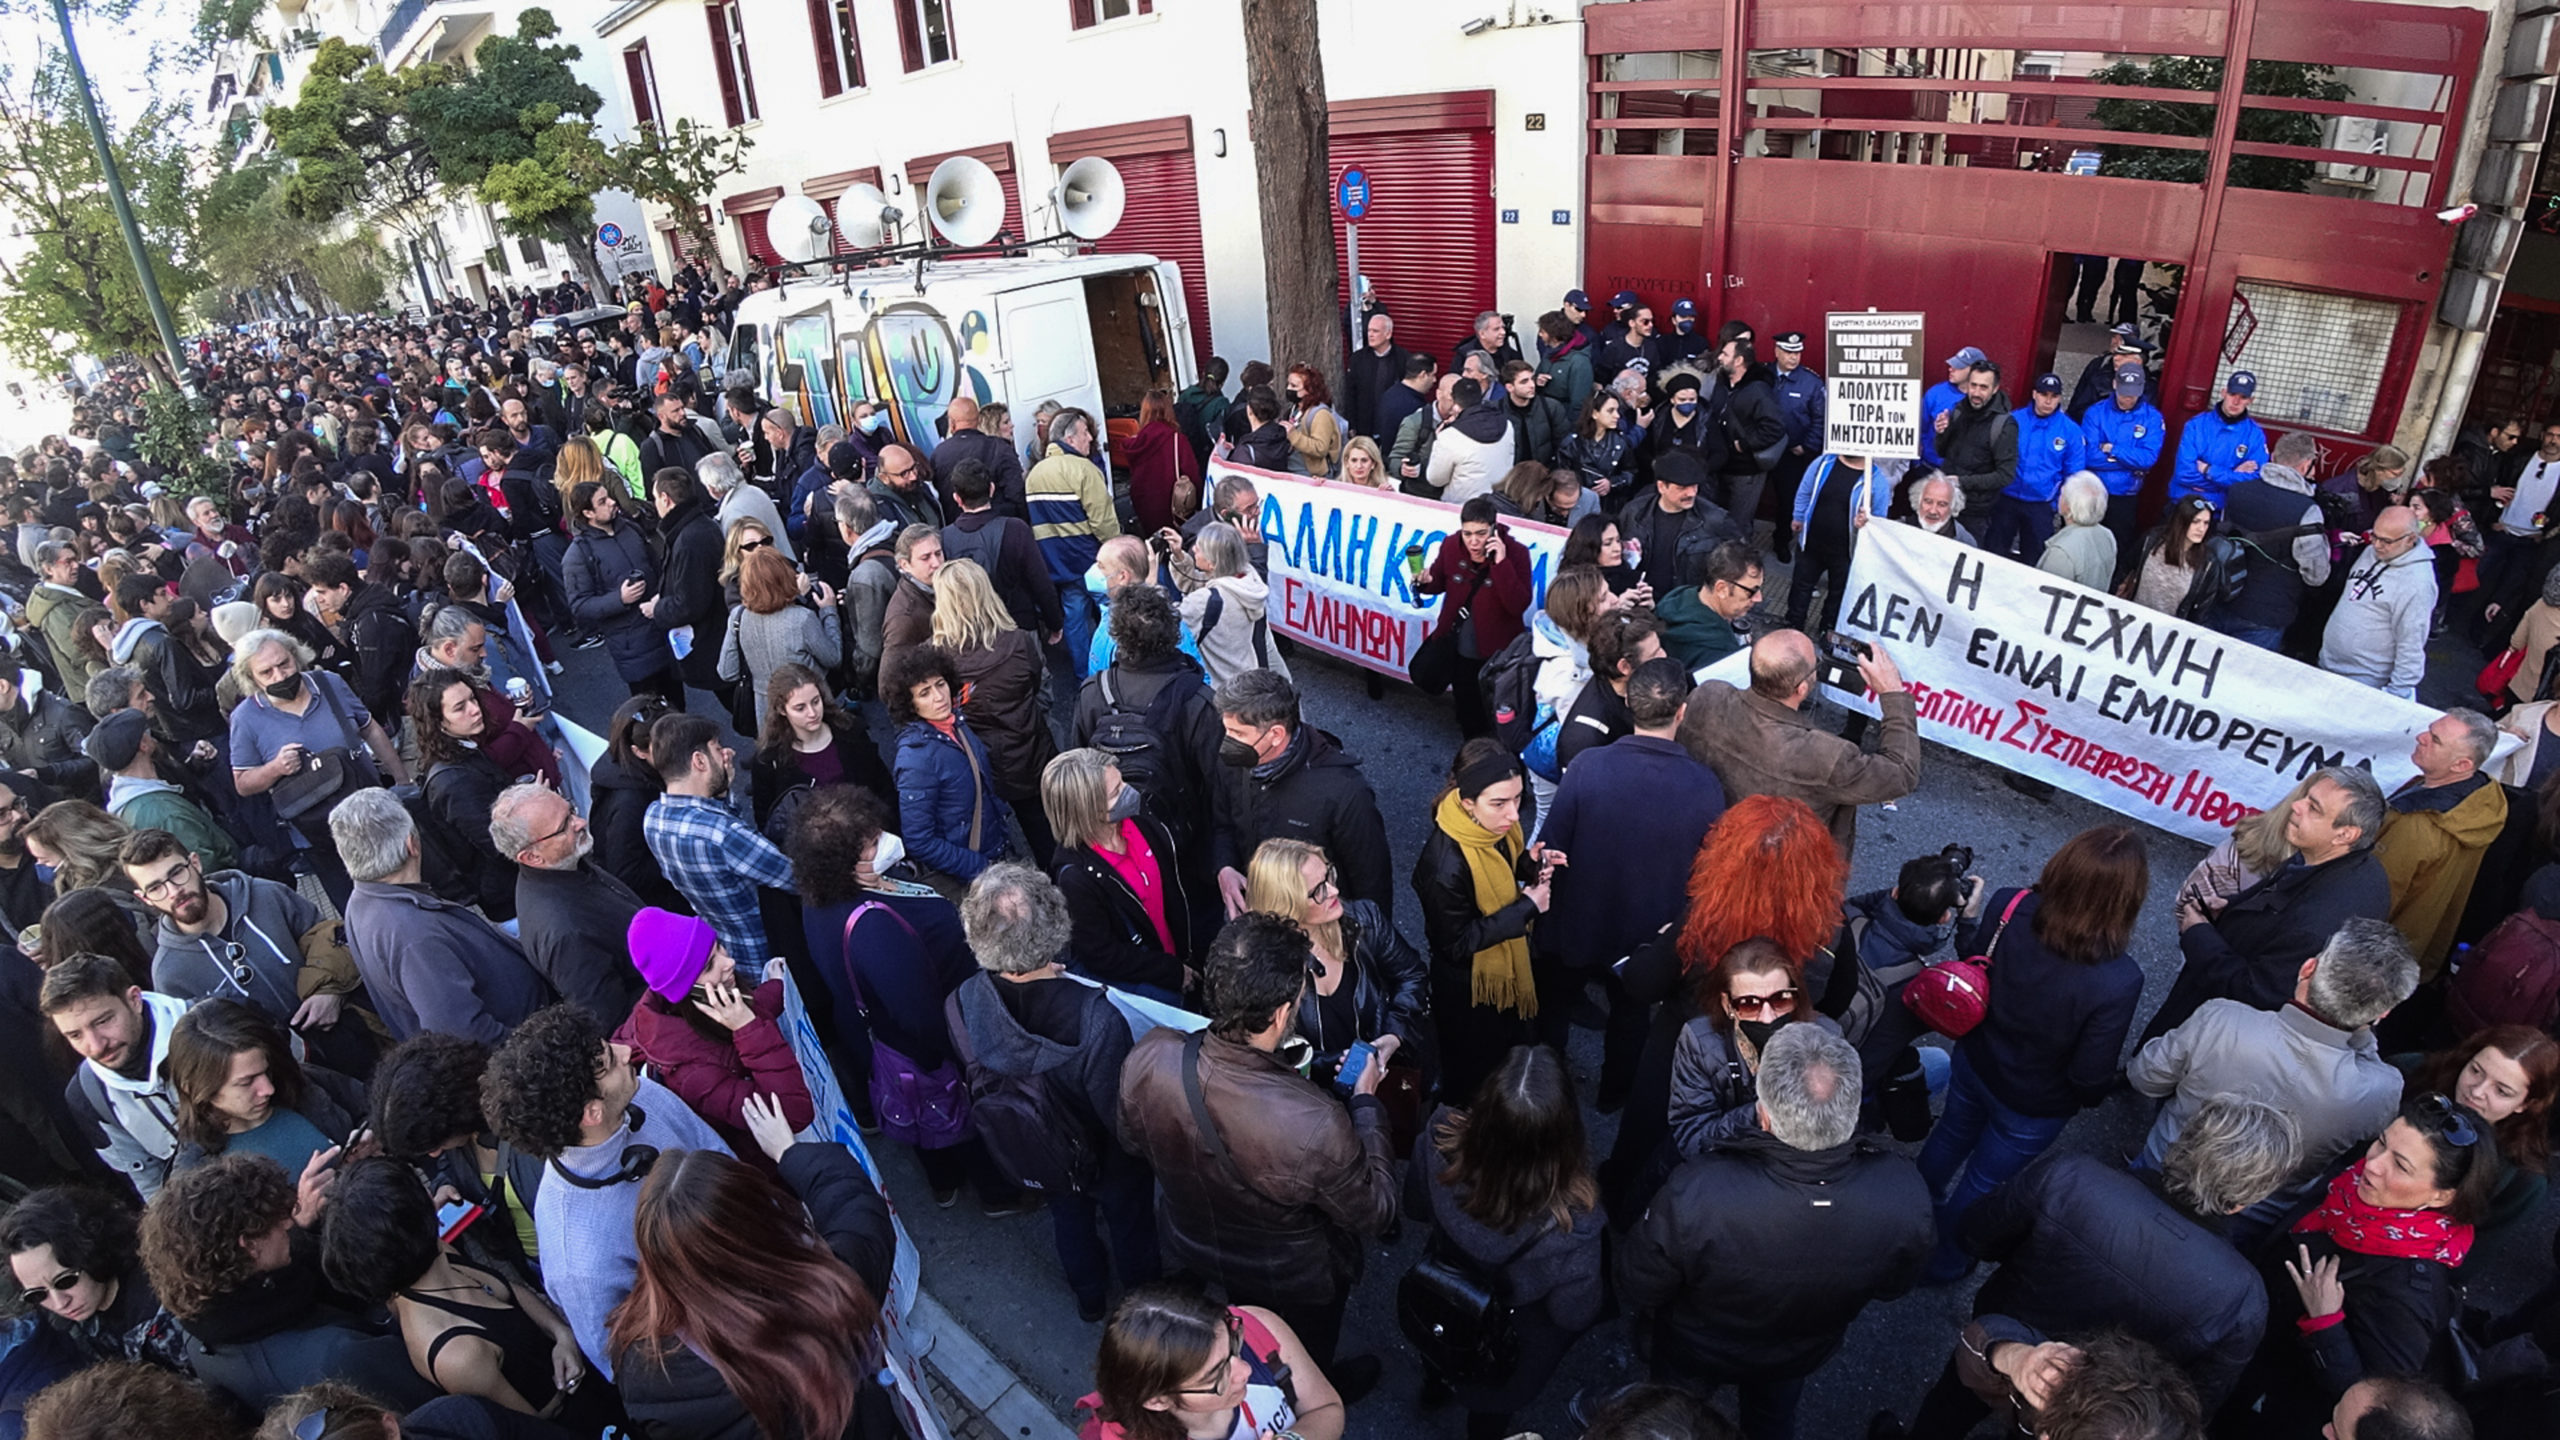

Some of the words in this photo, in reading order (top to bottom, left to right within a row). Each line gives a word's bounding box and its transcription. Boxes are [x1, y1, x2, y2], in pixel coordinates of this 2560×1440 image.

[1527, 115, 1543, 129] 22
[1504, 211, 1516, 222] 22
[1555, 212, 1567, 223] 20
[1838, 381, 1908, 401] ΑΠΟΛΥΣΤΕ
[1849, 403, 1884, 423] ΤΩΡΑ
[1888, 411, 1906, 424] ΤΟΝ
[1831, 423, 1915, 446] ΜΗΤΣΟΤΑΚΗ
[1285, 577, 1407, 667] ΕΛΛΗΝΩΝ
[1947, 552, 1985, 611] Η
[2039, 584, 2225, 699] ΤΕΧΝΗ
[1846, 582, 1944, 648] ΔΕΝ
[1965, 627, 2087, 703] ΕΙΝΑΙ
[2172, 769, 2265, 828] ΗΘΟ
